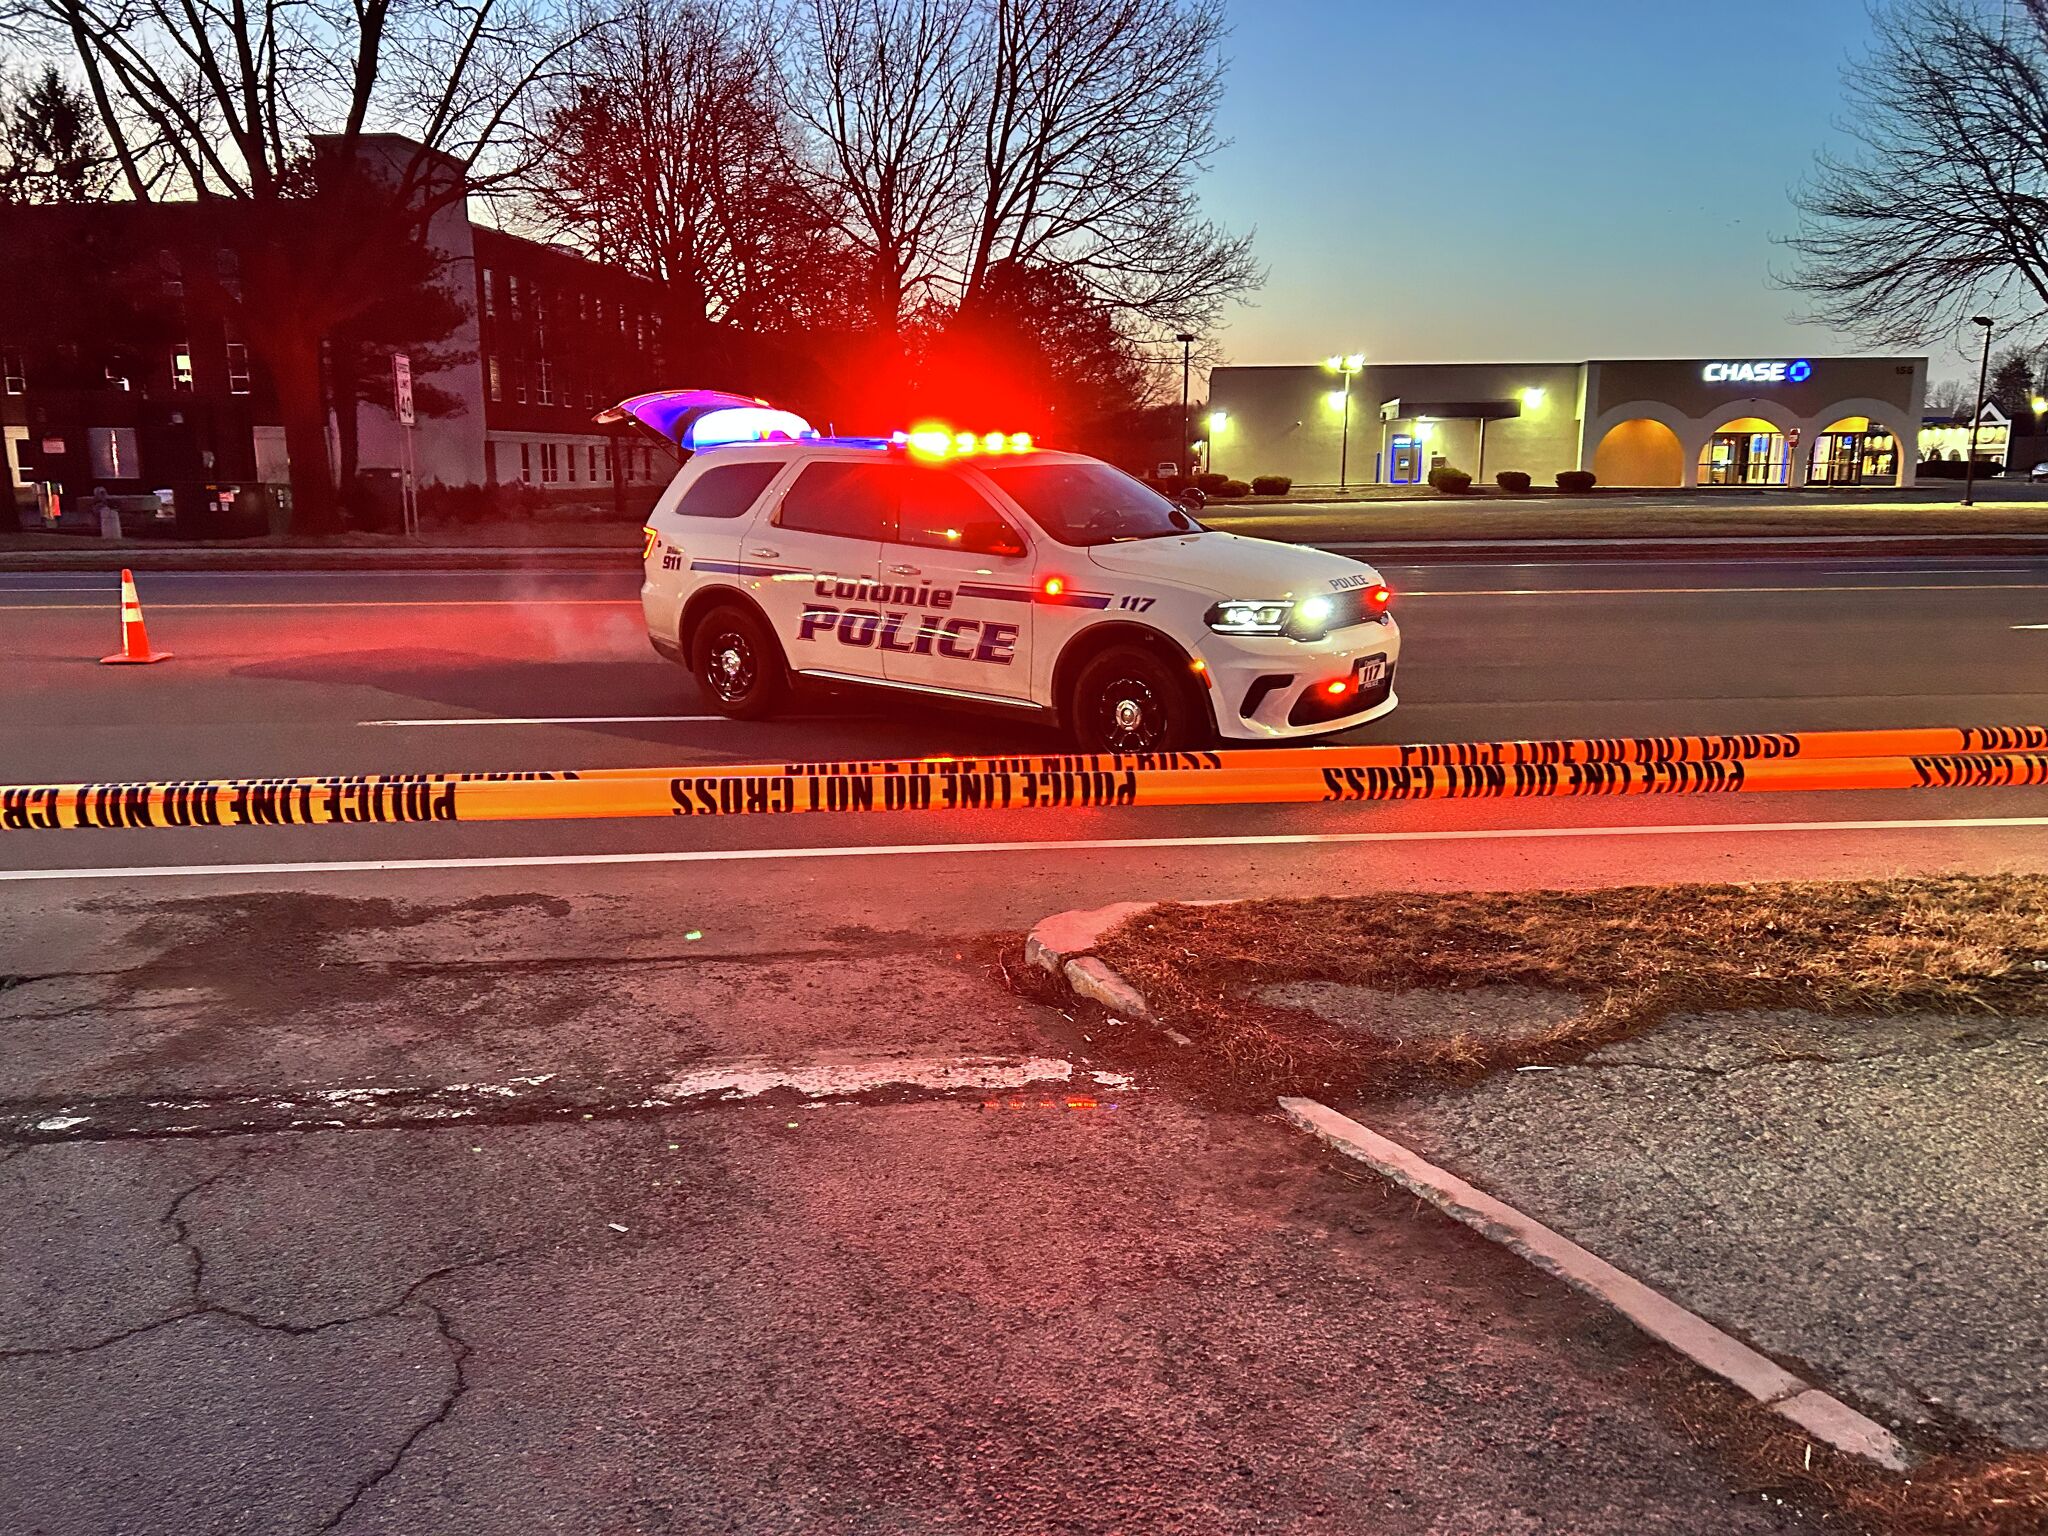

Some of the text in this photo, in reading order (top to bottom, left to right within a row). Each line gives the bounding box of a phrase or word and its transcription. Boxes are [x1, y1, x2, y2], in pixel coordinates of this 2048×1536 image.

[1702, 363, 1787, 381] CHASE
[401, 395, 412, 418] 40
[662, 555, 682, 570] 911
[814, 571, 954, 609] Colonie
[1328, 574, 1369, 590] POLICE
[1120, 595, 1156, 613] 117
[797, 602, 1020, 665] POLICE
[1363, 664, 1381, 682] 117
[1960, 728, 2048, 751] POLIC
[671, 771, 1136, 816] POLICE LINE DO NOT CROSS
[1322, 760, 1744, 801] POLICE LINE DO NOT CROSS
[75, 787, 151, 829] NOT
[163, 786, 219, 826] DO
[230, 784, 312, 825] LINE
[323, 782, 457, 823] POLICE
